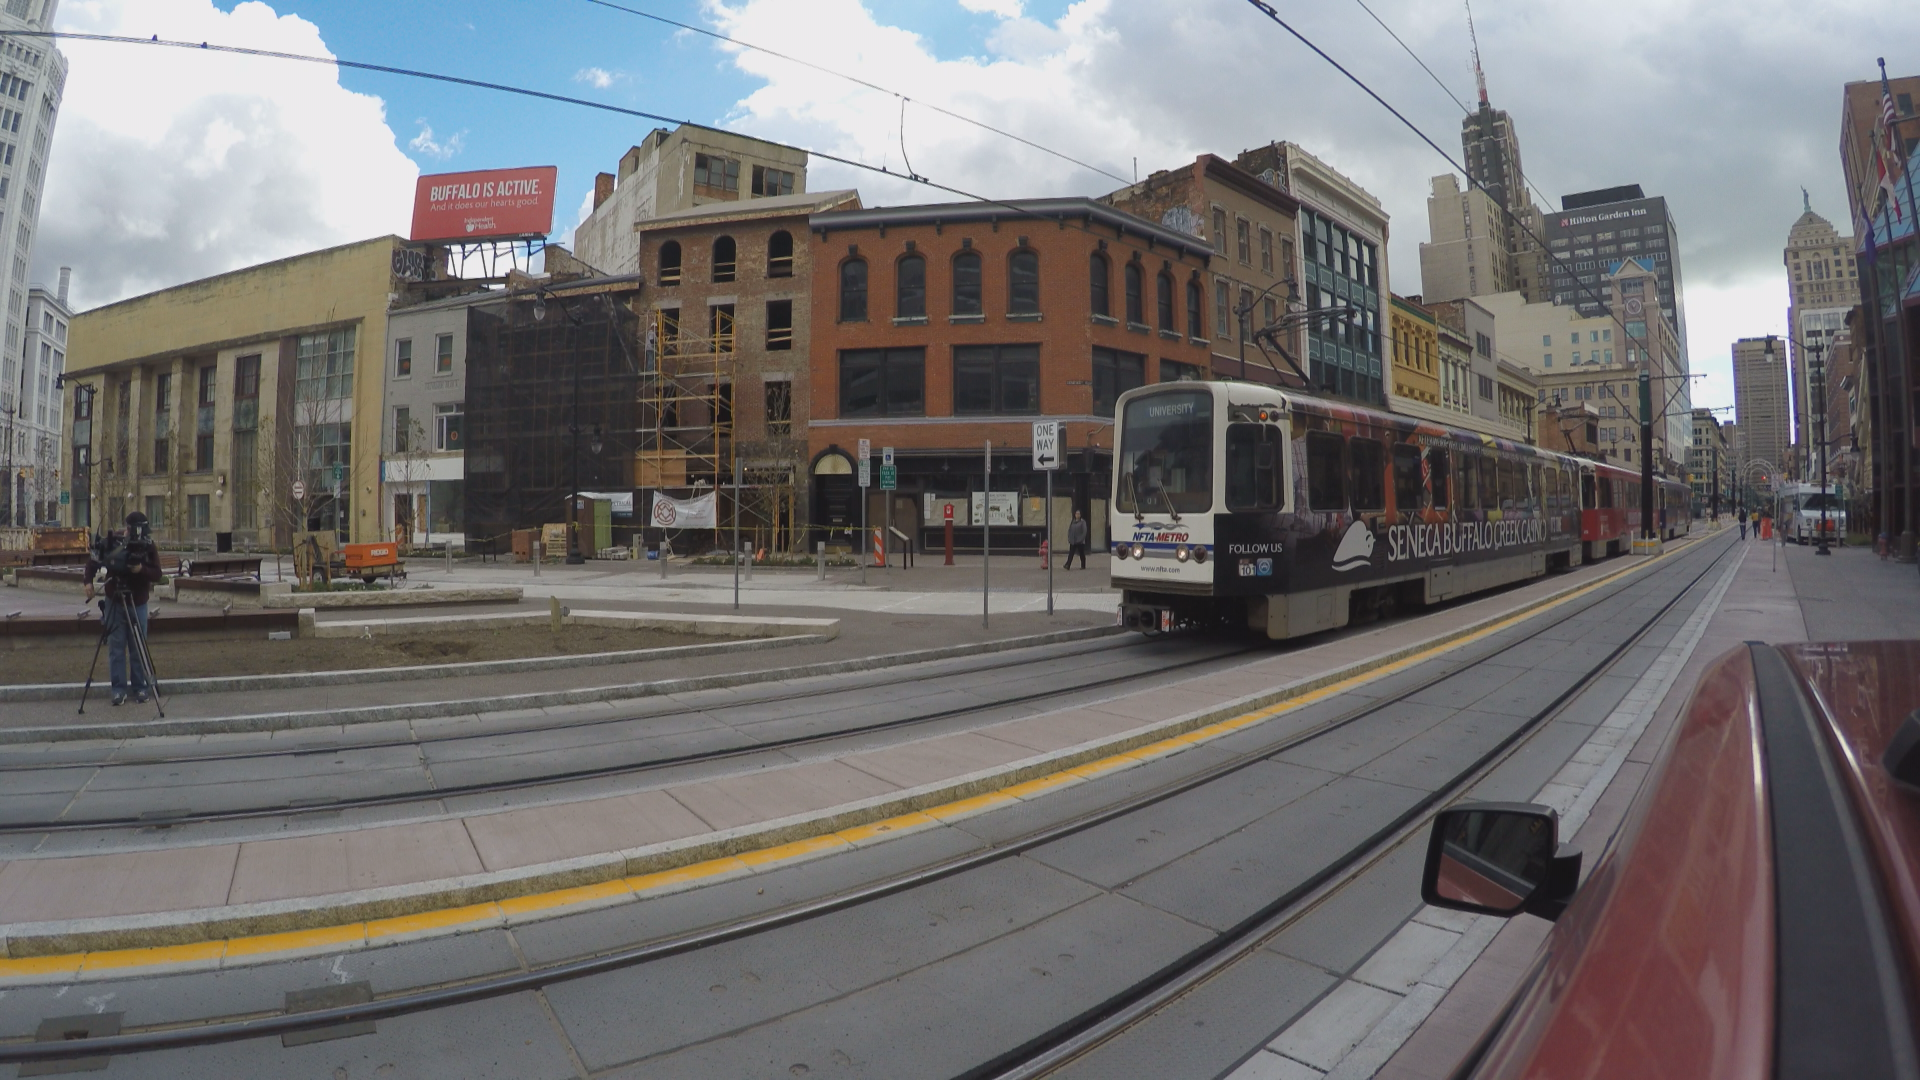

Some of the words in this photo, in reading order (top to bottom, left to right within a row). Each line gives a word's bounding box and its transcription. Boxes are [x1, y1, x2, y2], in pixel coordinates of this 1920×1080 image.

[430, 183, 480, 202] BUFFALO
[483, 182, 495, 198] IS
[497, 179, 542, 197] ACTIVE.
[430, 203, 446, 212] And
[447, 202, 453, 210] it
[455, 201, 473, 210] does
[490, 198, 515, 207] hearts
[464, 216, 494, 224] Independent
[1569, 215, 1597, 226] Hilton
[1598, 210, 1630, 221] Garden
[1631, 207, 1647, 216] Inn
[1149, 402, 1195, 418] UNIVERSITY
[1036, 424, 1055, 437] ONE
[1036, 438, 1055, 451] WAY
[1387, 523, 1442, 562] SENECA
[1443, 517, 1493, 553] BUFFALO
[1494, 519, 1521, 550] CREEK
[1521, 517, 1547, 543] CASINO
[1229, 544, 1269, 555] FOLLOW
[1270, 543, 1283, 553] US
[1141, 565, 1180, 574] www.nfta.com
